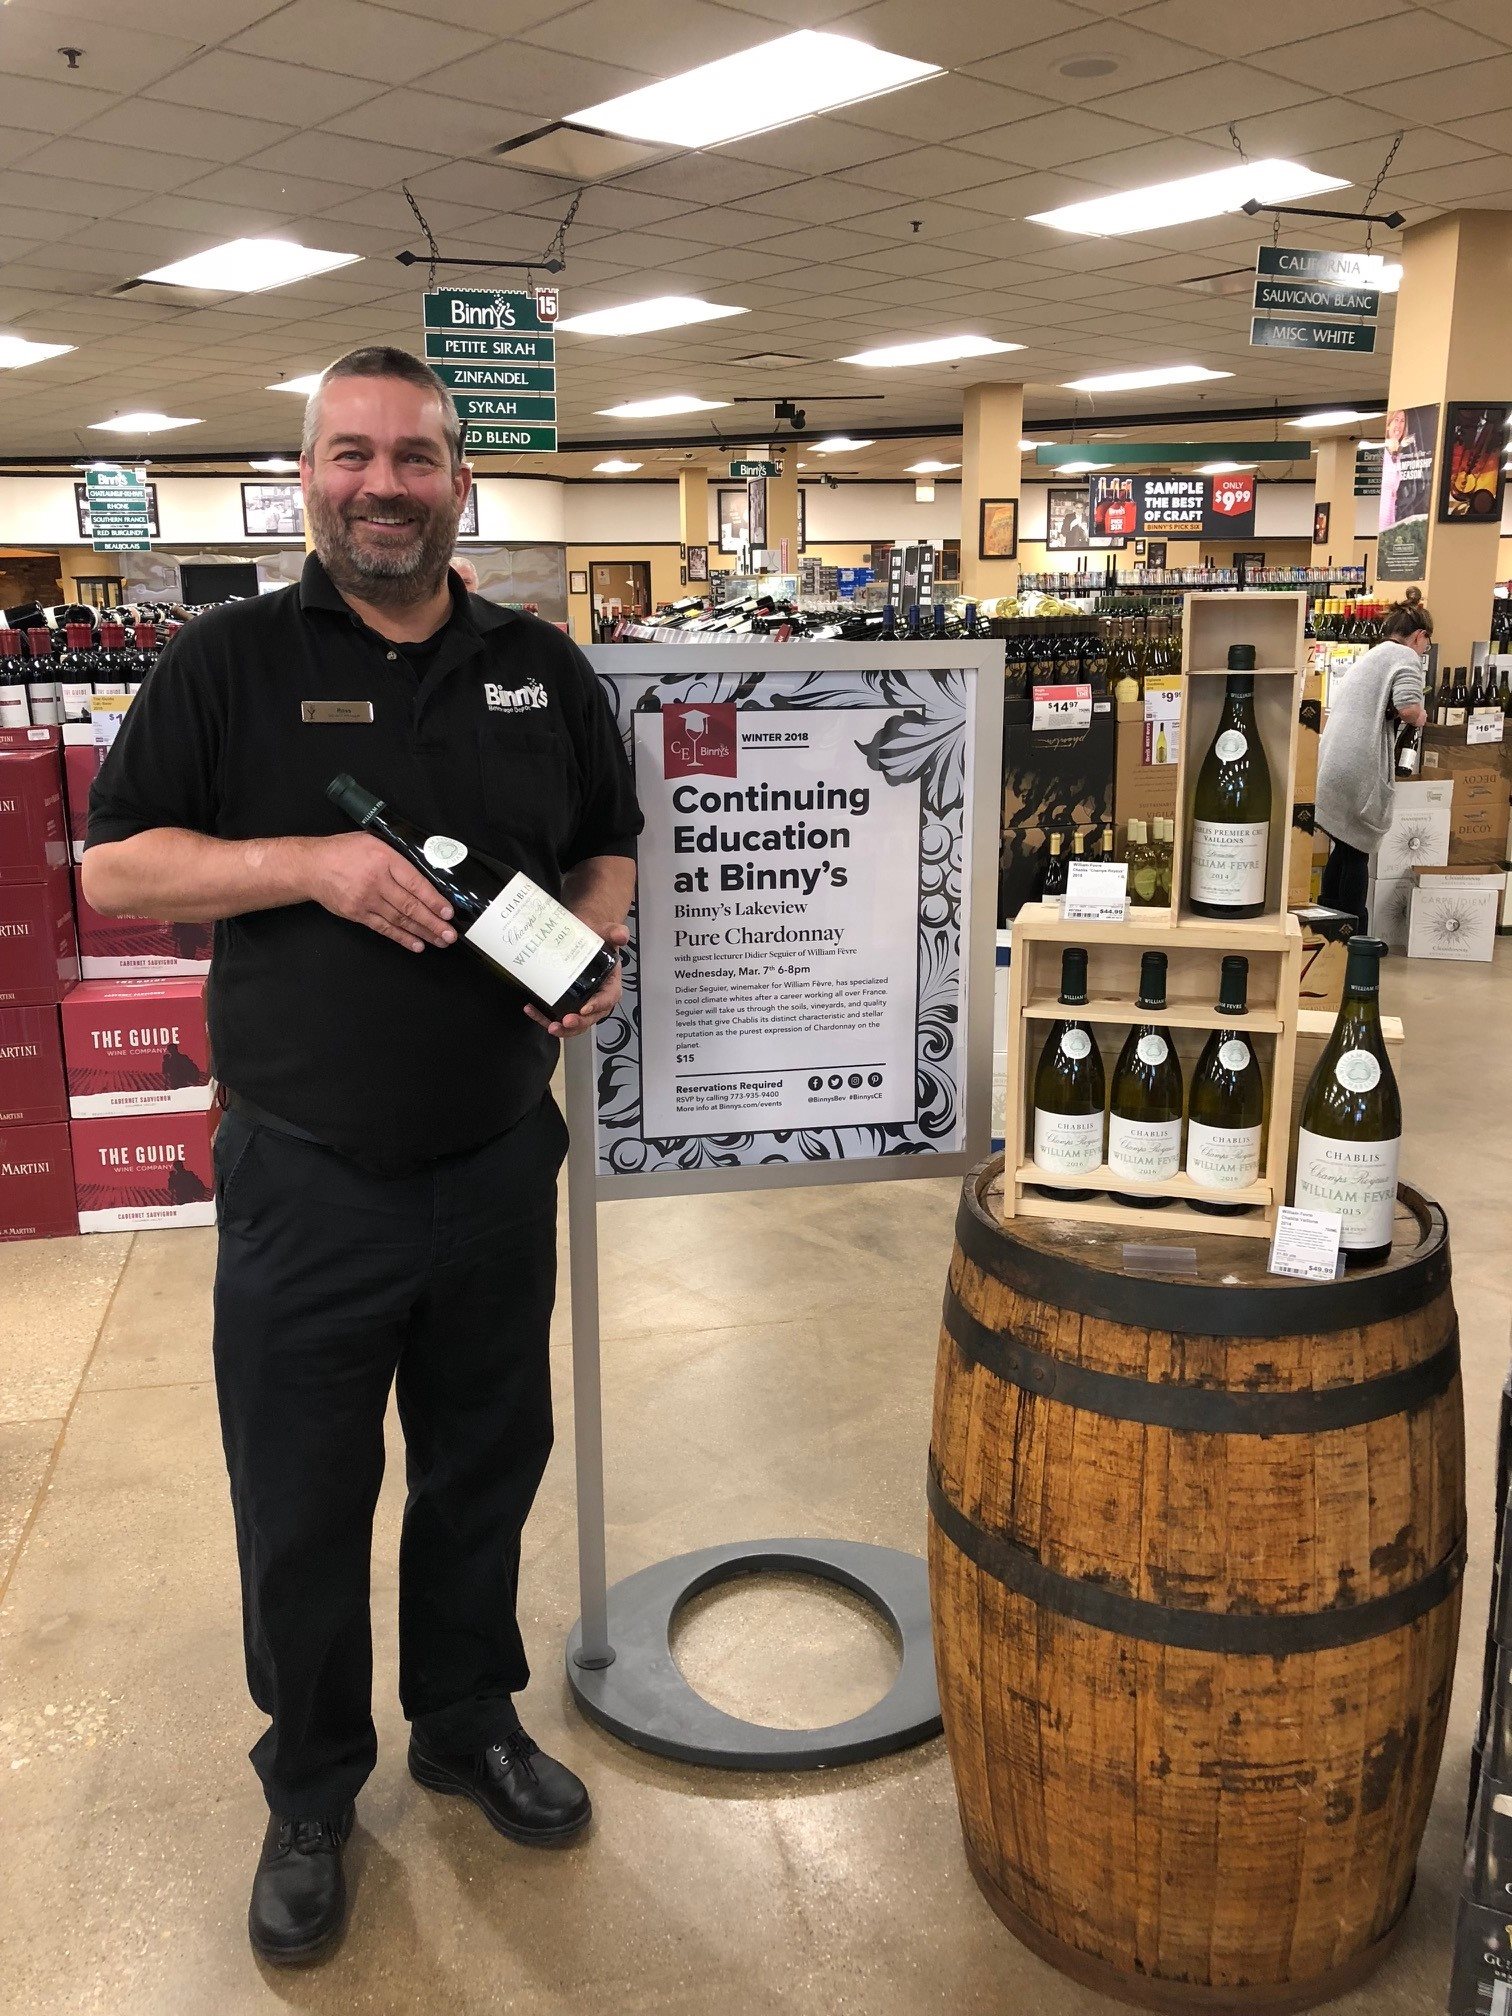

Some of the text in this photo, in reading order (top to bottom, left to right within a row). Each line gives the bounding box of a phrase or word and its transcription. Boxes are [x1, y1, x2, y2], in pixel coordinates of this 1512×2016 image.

[1279, 255, 1361, 274] CALIFRNIA
[539, 296, 556, 315] 15
[1262, 288, 1372, 309] SAUVIGNON BLANC
[451, 297, 516, 330] Binny's
[1273, 326, 1356, 345] MISC. WHITE
[445, 340, 536, 355] PETITE SIRAH
[454, 370, 529, 385] ZINFANDEL
[468, 401, 517, 414] SYRAH
[487, 432, 531, 445] BLEND
[1144, 481, 1204, 496] SAMPLE
[1222, 481, 1244, 490] ONLY
[1145, 497, 1203, 509] THE BEST
[1144, 511, 1203, 522] OF CRAFT
[484, 682, 548, 709] Binny's
[742, 732, 809, 743] WINTER 2018
[701, 744, 729, 758] Binny's
[673, 780, 870, 816] Continuing
[1214, 829, 1250, 837] PREMIER
[1459, 824, 1493, 834] DECOY
[674, 821, 850, 853] Education
[1203, 835, 1244, 844] VAILLONS
[673, 860, 848, 895] at Binny's
[500, 882, 532, 919] CHABLIS
[674, 900, 808, 922] Binny's Lakeview
[512, 917, 558, 966] WILLIAM
[555, 925, 571, 945] 2015
[674, 925, 845, 948] Pure Chardonnay
[674, 948, 836, 963] with guest lecturer Didier Seguier of William
[674, 964, 811, 979] Wednesday, Mar. 7th 6-8pm
[675, 986, 697, 994] Didier
[730, 983, 769, 991] winemaker
[849, 977, 889, 986] specialized
[684, 996, 699, 1004] cool
[701, 995, 728, 1004] climate
[729, 994, 753, 1002] whites
[754, 993, 772, 1001] after
[804, 991, 833, 1000] working
[862, 988, 888, 996] France.
[675, 1008, 703, 1017] Seguier
[719, 1006, 735, 1014] take
[747, 1004, 776, 1013] through
[777, 1003, 789, 1011] the
[790, 1003, 809, 1011] soils,
[810, 1001, 846, 1010] vineyards,
[847, 1000, 861, 1008] and
[862, 998, 887, 1008] quality
[675, 1019, 697, 1027] levels
[698, 1018, 713, 1026] that
[714, 1019, 731, 1027] give
[731, 1016, 759, 1024] Chablis
[760, 1015, 769, 1023] its
[770, 1014, 797, 1022] distinct
[798, 1012, 846, 1021] characteristic
[862, 1010, 884, 1018] stellar
[91, 1026, 180, 1049] THE GUIDE
[675, 1030, 714, 1039] reputation
[725, 1028, 738, 1036] the
[739, 1027, 763, 1036] purest
[764, 1025, 802, 1035] expression
[804, 1023, 812, 1032] of
[813, 1022, 856, 1032] Chardonnay
[107, 1047, 168, 1057] WINE COMPANY
[676, 1053, 695, 1063] $15
[676, 1079, 783, 1093] Reservations Required
[695, 1095, 704, 1103] by
[706, 1094, 729, 1102] calling
[730, 1091, 779, 1100] 773-935-9400
[695, 1104, 709, 1112] info
[718, 1100, 783, 1111] Binnys.com/events
[1057, 1122, 1094, 1130] CHABLIS
[1130, 1129, 1168, 1137] CHABLIS
[1212, 1136, 1251, 1144] CHABLIS
[99, 1144, 186, 1166] THE GUIDE
[1040, 1144, 1080, 1158] WILLIAM
[1113, 1151, 1154, 1165] WILLIAM
[1325, 1150, 1380, 1162] CHABLIS
[1, 1161, 50, 1176] MARTINI
[136, 1164, 174, 1172] COMPANY
[1193, 1158, 1236, 1172] WILLIAM
[1300, 1179, 1358, 1203] WILLIAM
[1335, 1207, 1362, 1216] 2015
[1308, 1265, 1334, 1274] $49.99
